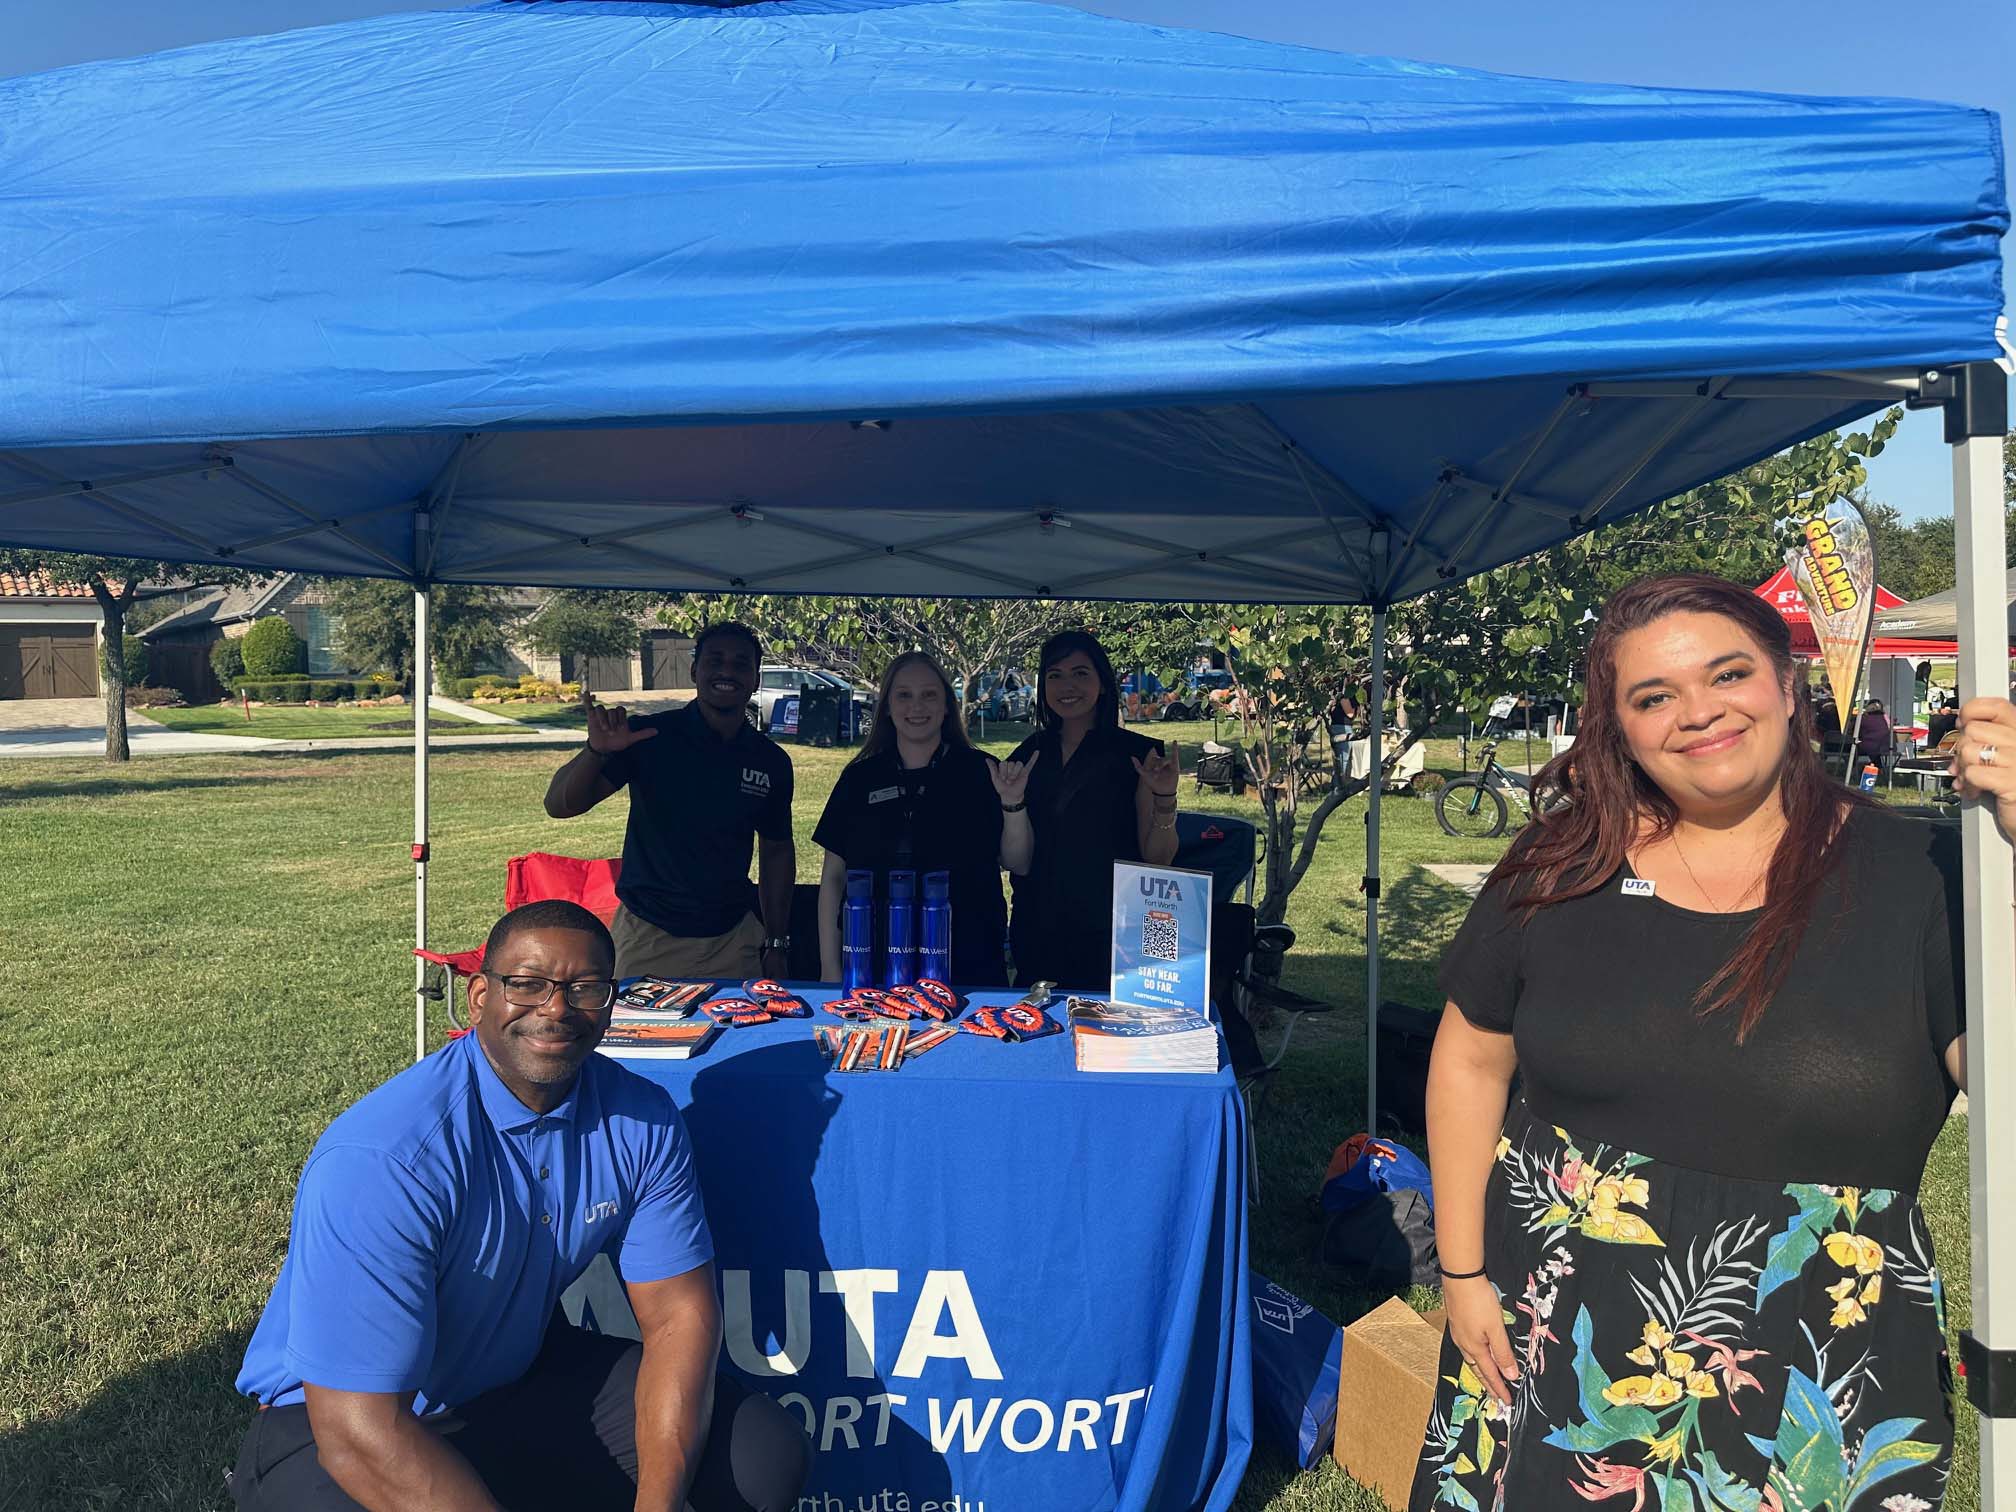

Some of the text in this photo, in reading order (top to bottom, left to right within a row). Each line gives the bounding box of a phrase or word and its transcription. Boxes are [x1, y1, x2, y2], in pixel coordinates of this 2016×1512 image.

[1806, 520, 1858, 609] GRAND
[1804, 556, 1835, 616] ADVENTURE
[742, 768, 771, 788] UTA
[1140, 877, 1182, 901] UTA
[1625, 880, 1651, 890] UTA
[1144, 899, 1178, 911] Fort Worth
[1138, 966, 1157, 979] STAY
[920, 982, 951, 1003] UTA
[1144, 979, 1155, 990] GO
[624, 994, 646, 1005] UTA
[1005, 1007, 1036, 1026] UTA
[584, 1200, 619, 1223] UTA
[1262, 1307, 1286, 1321] UTA
[723, 1269, 1004, 1380] UTA
[770, 1385, 1154, 1454] ORT WORT
